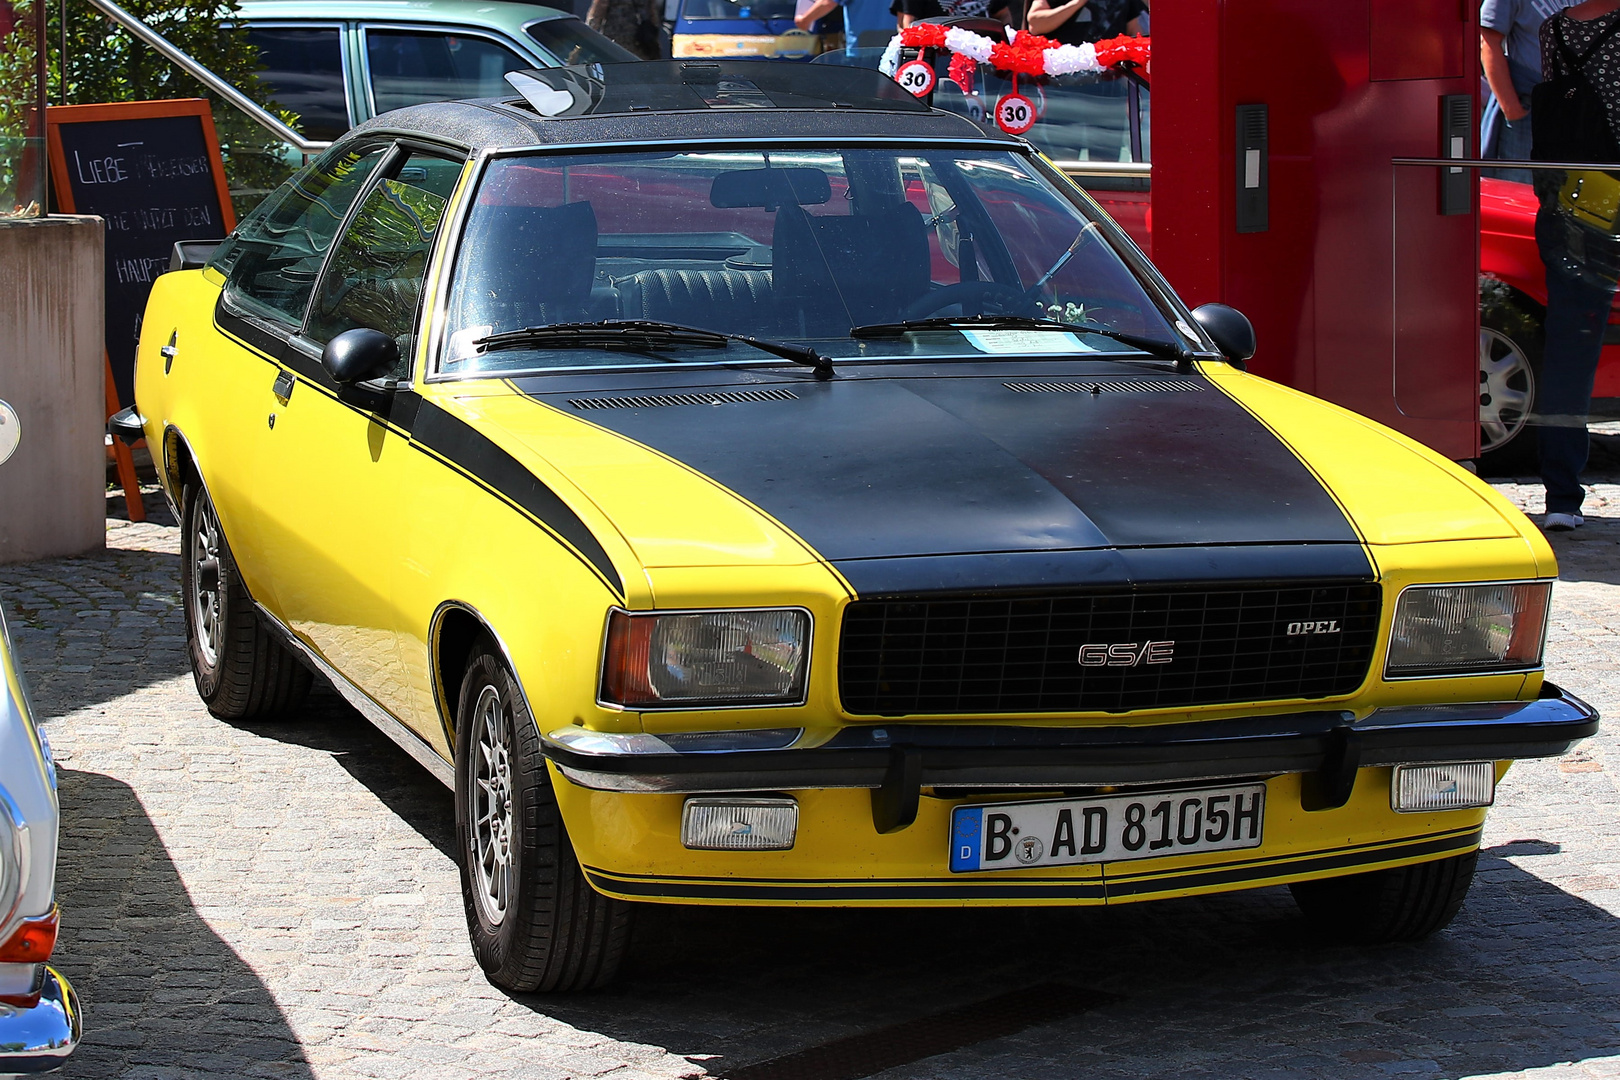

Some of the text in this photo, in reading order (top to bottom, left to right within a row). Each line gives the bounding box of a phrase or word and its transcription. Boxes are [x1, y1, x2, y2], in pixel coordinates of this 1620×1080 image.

[903, 72, 926, 87] 30
[1004, 105, 1027, 122] 30
[74, 150, 129, 184] LIEBE
[1286, 620, 1341, 636] OPEL
[1078, 640, 1175, 667] GS/E
[960, 845, 972, 860] D
[985, 813, 1013, 862] B
[1050, 806, 1108, 857] AD
[1121, 792, 1261, 852] 8105H
